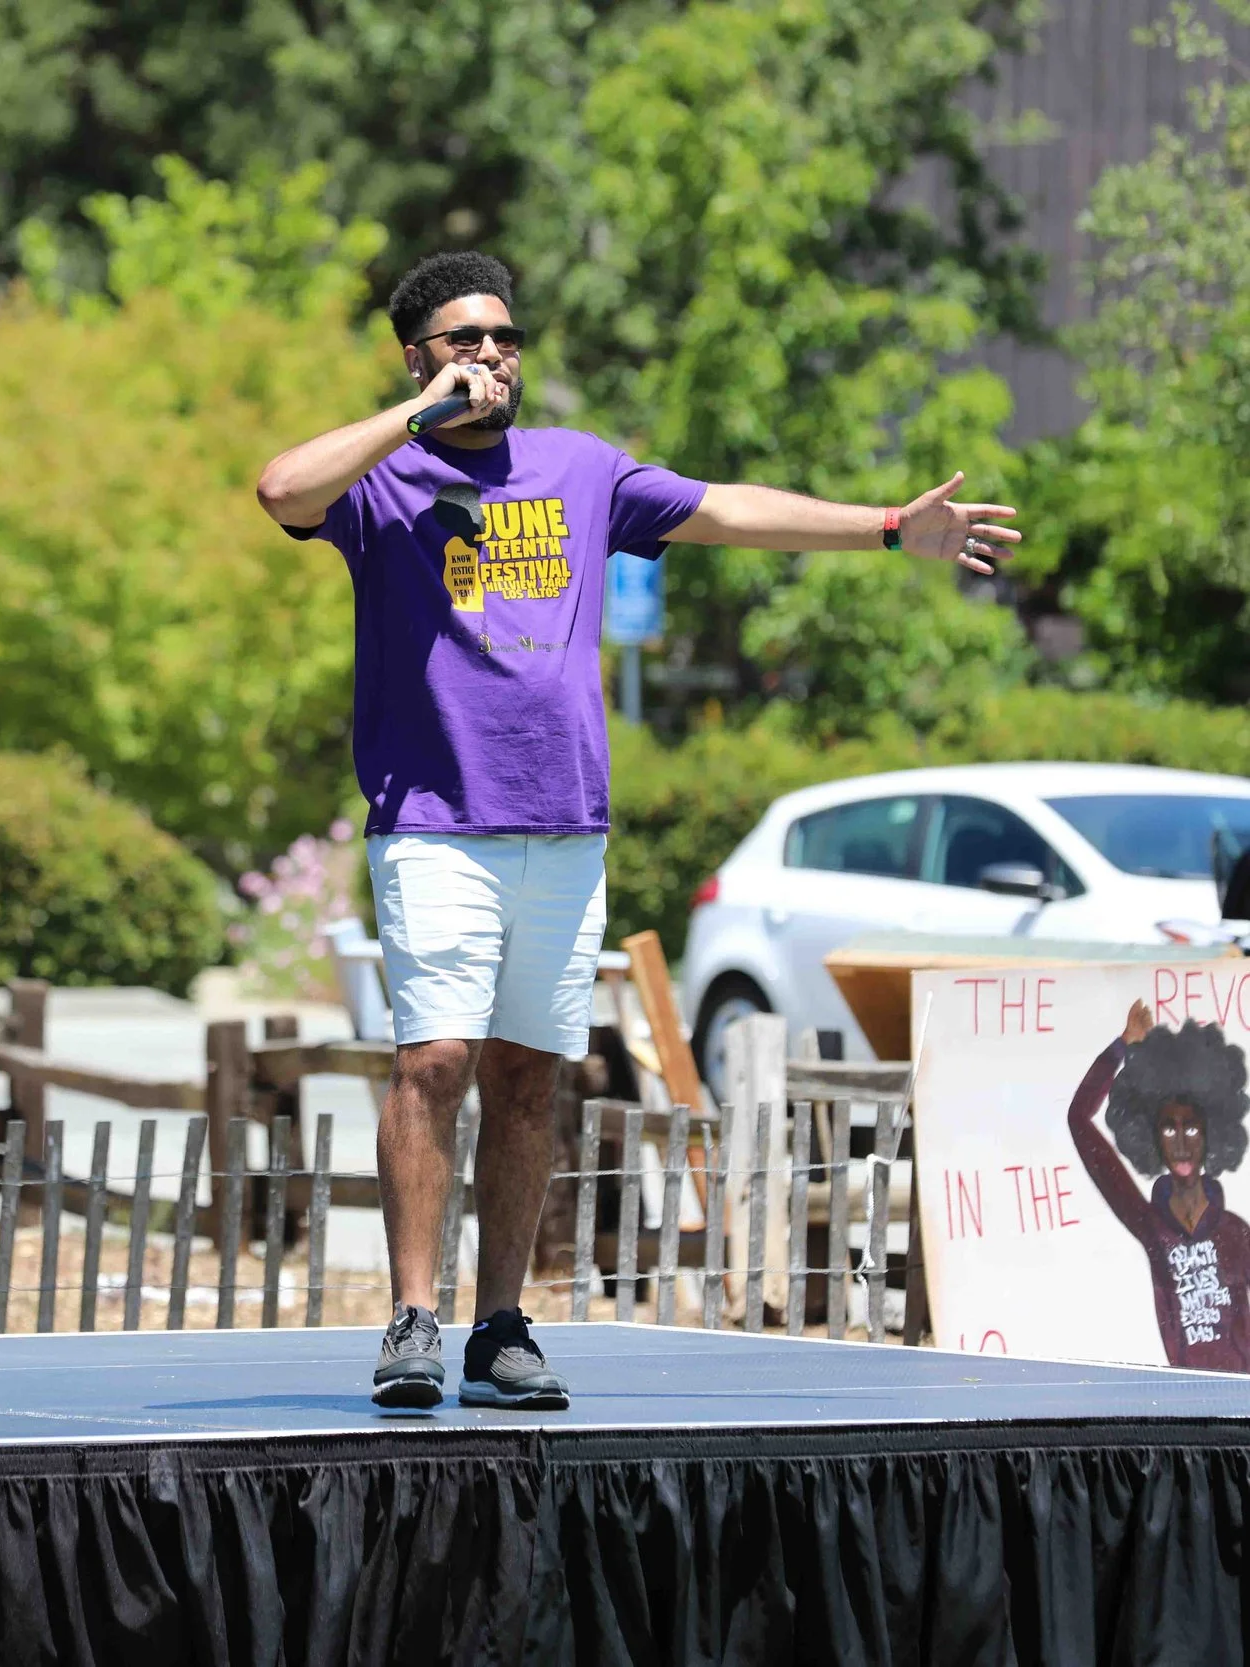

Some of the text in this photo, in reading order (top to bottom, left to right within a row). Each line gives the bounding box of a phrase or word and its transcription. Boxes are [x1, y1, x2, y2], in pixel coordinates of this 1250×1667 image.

[474, 498, 569, 541] JUNE
[486, 537, 562, 560] TEENTH
[451, 554, 471, 563] KNOW
[451, 566, 475, 576] JUSTICE
[480, 558, 572, 583] FESTIVAL
[453, 577, 473, 586] KNOW
[486, 577, 569, 593] HILLVIEW PARK
[502, 586, 561, 600] LOS ALTOS
[954, 978, 1056, 1035] THE
[944, 1166, 1081, 1241] IN THE
